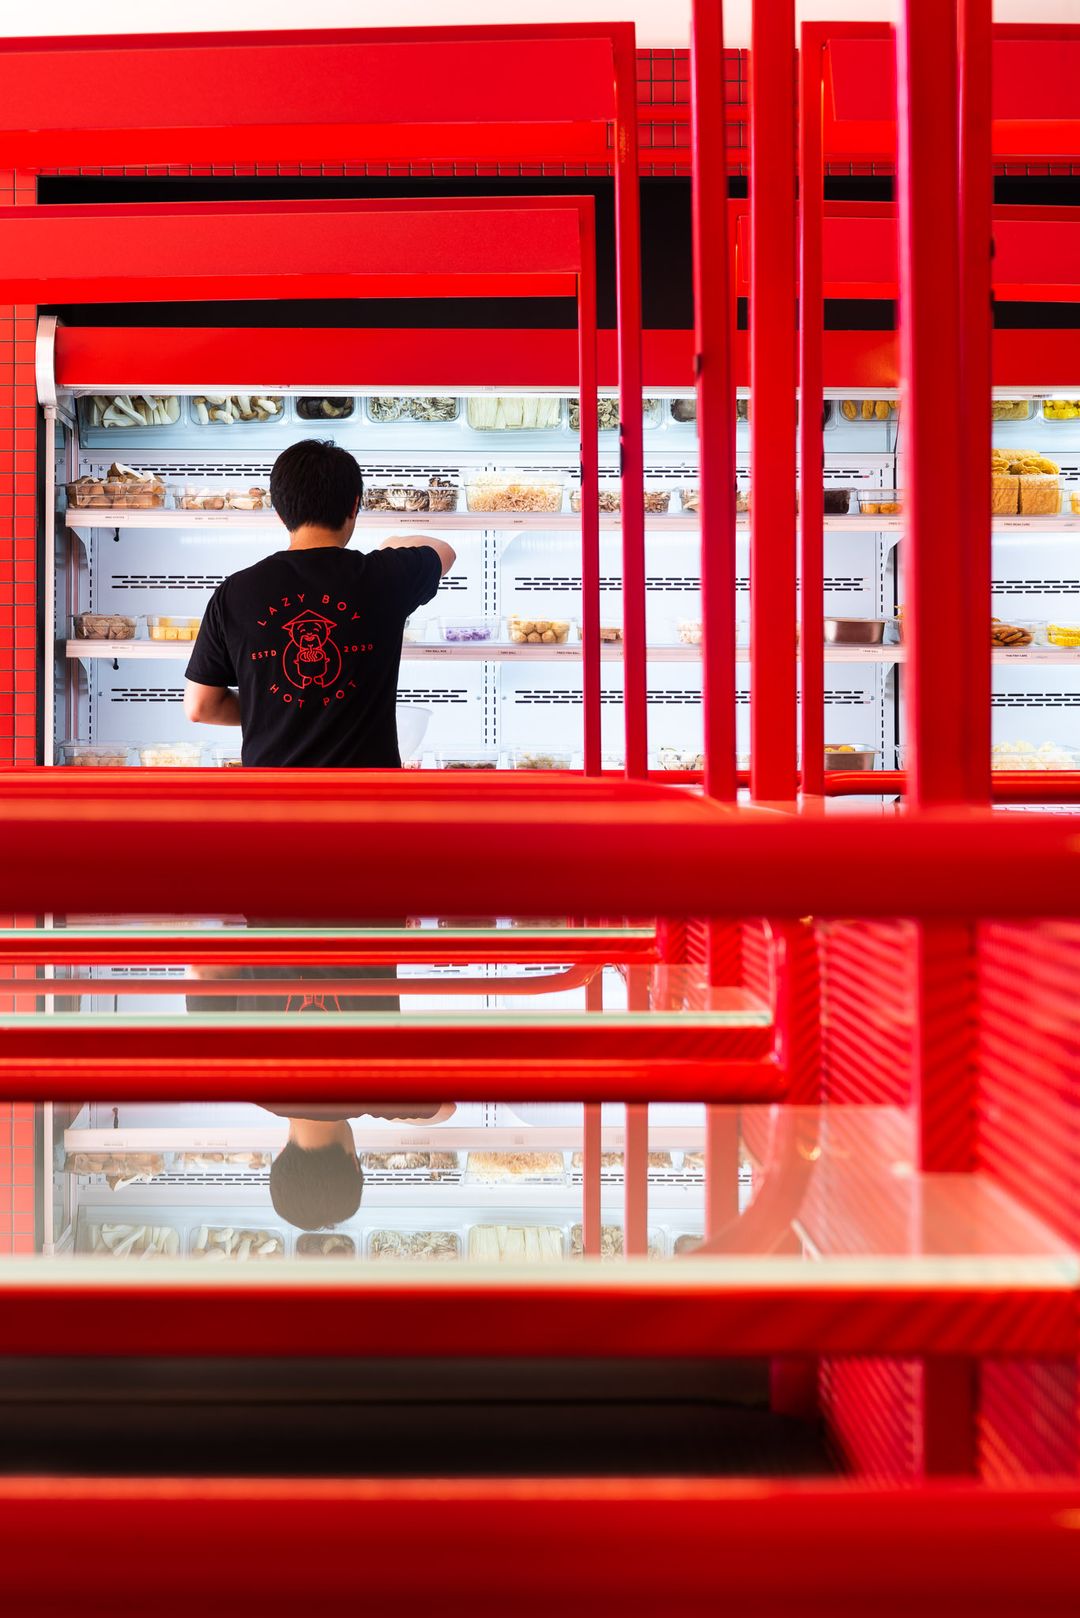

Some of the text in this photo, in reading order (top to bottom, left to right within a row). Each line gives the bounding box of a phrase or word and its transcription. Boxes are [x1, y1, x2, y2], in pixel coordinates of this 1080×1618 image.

[257, 593, 361, 626] LAZY BOY
[251, 643, 374, 660] ESTD 2020
[269, 680, 357, 709] HOT POT
